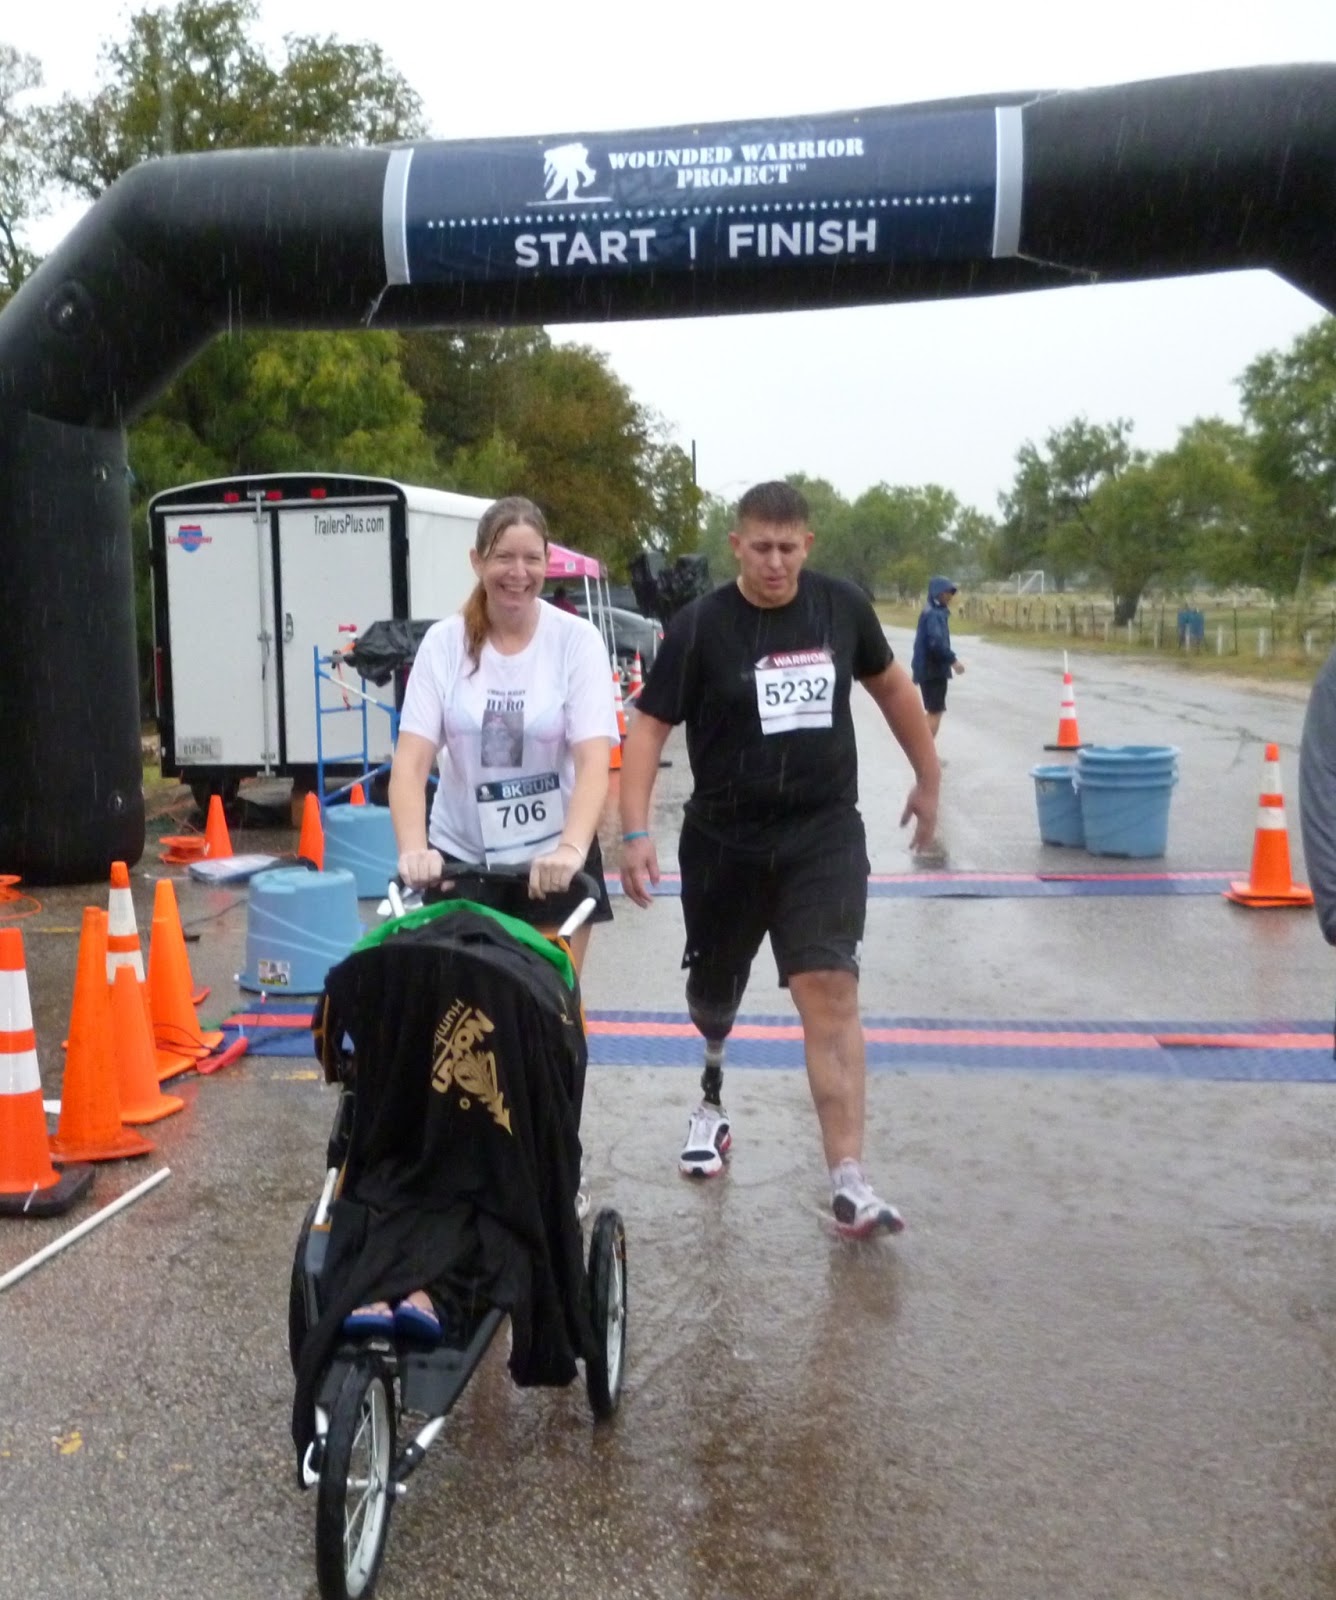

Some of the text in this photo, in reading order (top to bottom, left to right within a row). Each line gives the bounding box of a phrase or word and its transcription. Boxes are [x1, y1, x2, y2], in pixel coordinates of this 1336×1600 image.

[608, 138, 865, 170] WOUNDED WARRIOR
[676, 163, 792, 189] PROJECT
[514, 218, 877, 268] START FINISH
[313, 513, 385, 535] TrailersPlus.com
[773, 652, 827, 667] WARRIOR
[486, 699, 525, 712] HERO
[765, 677, 829, 707] 5232
[497, 800, 546, 829] 706
